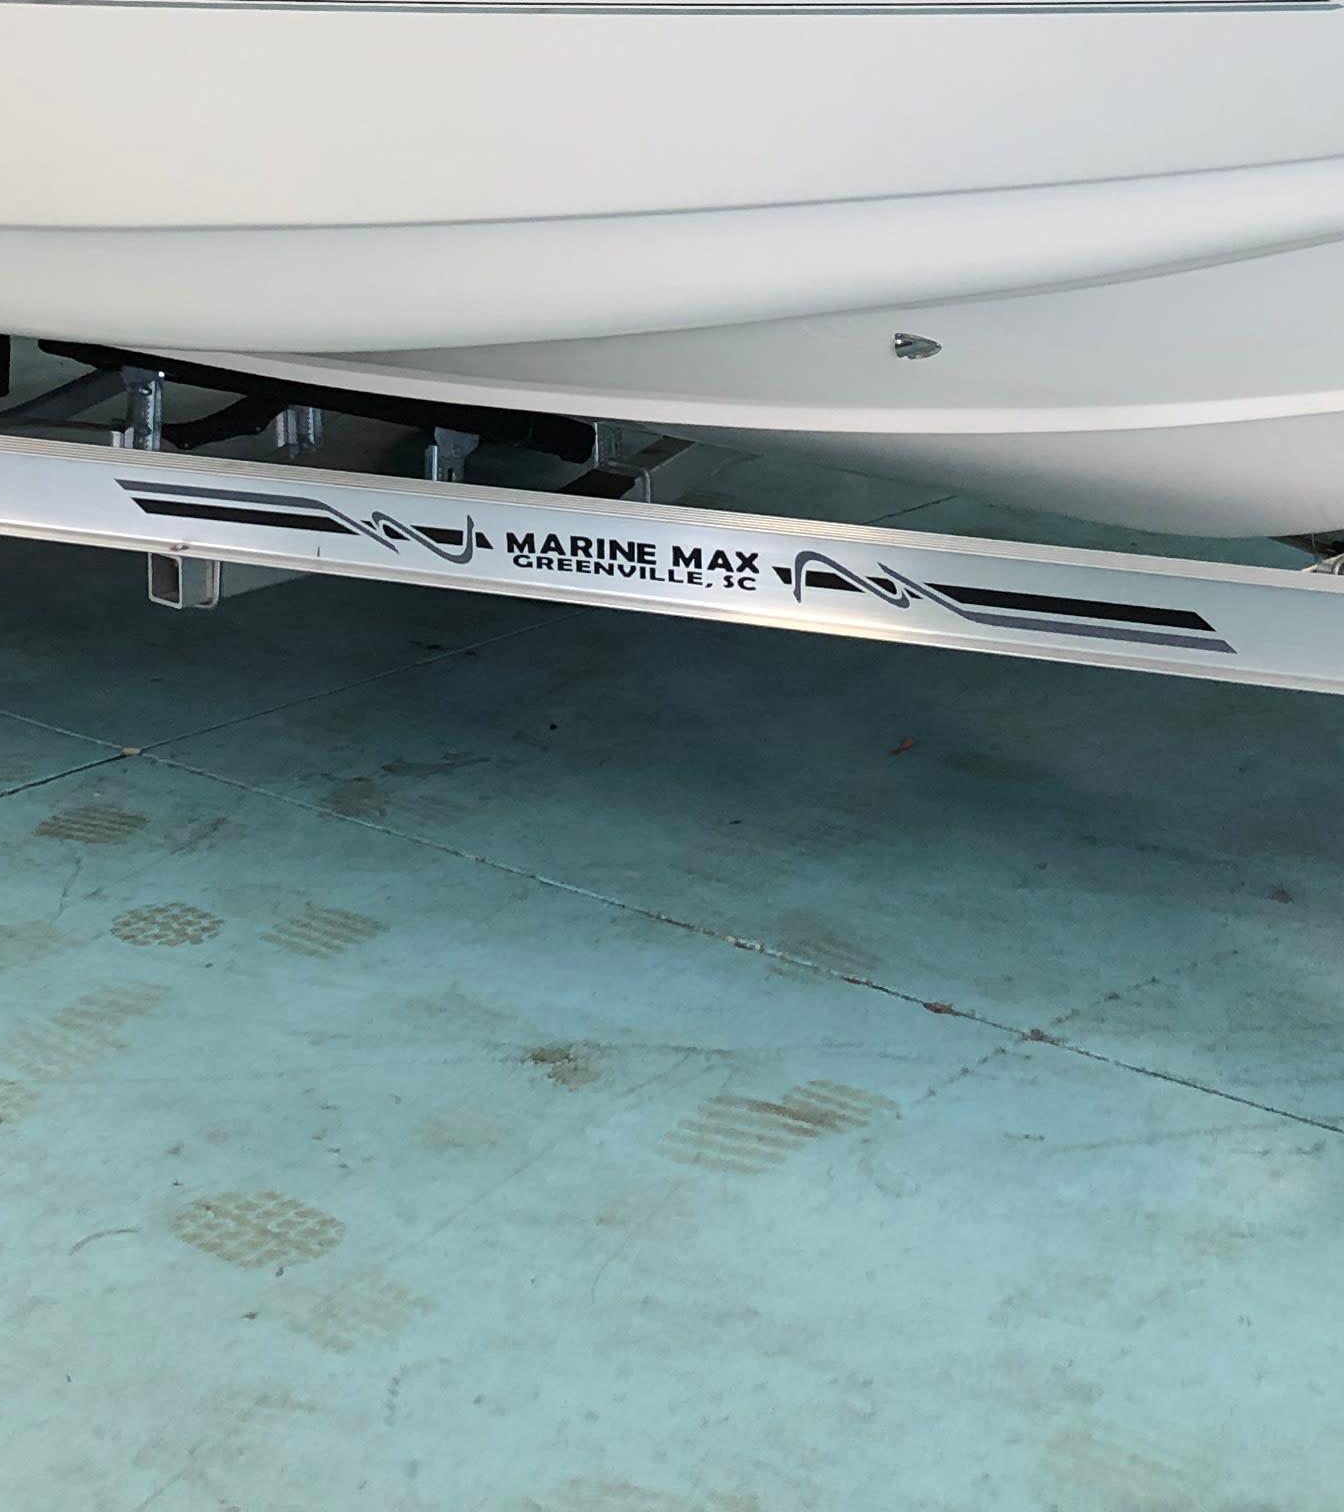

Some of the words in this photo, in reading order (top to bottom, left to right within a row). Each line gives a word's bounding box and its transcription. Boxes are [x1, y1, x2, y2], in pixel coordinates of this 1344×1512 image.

[506, 532, 656, 567] MARINE
[672, 545, 760, 574] MAX
[512, 554, 714, 589] GREENVILLE,
[723, 575, 758, 591] SC
